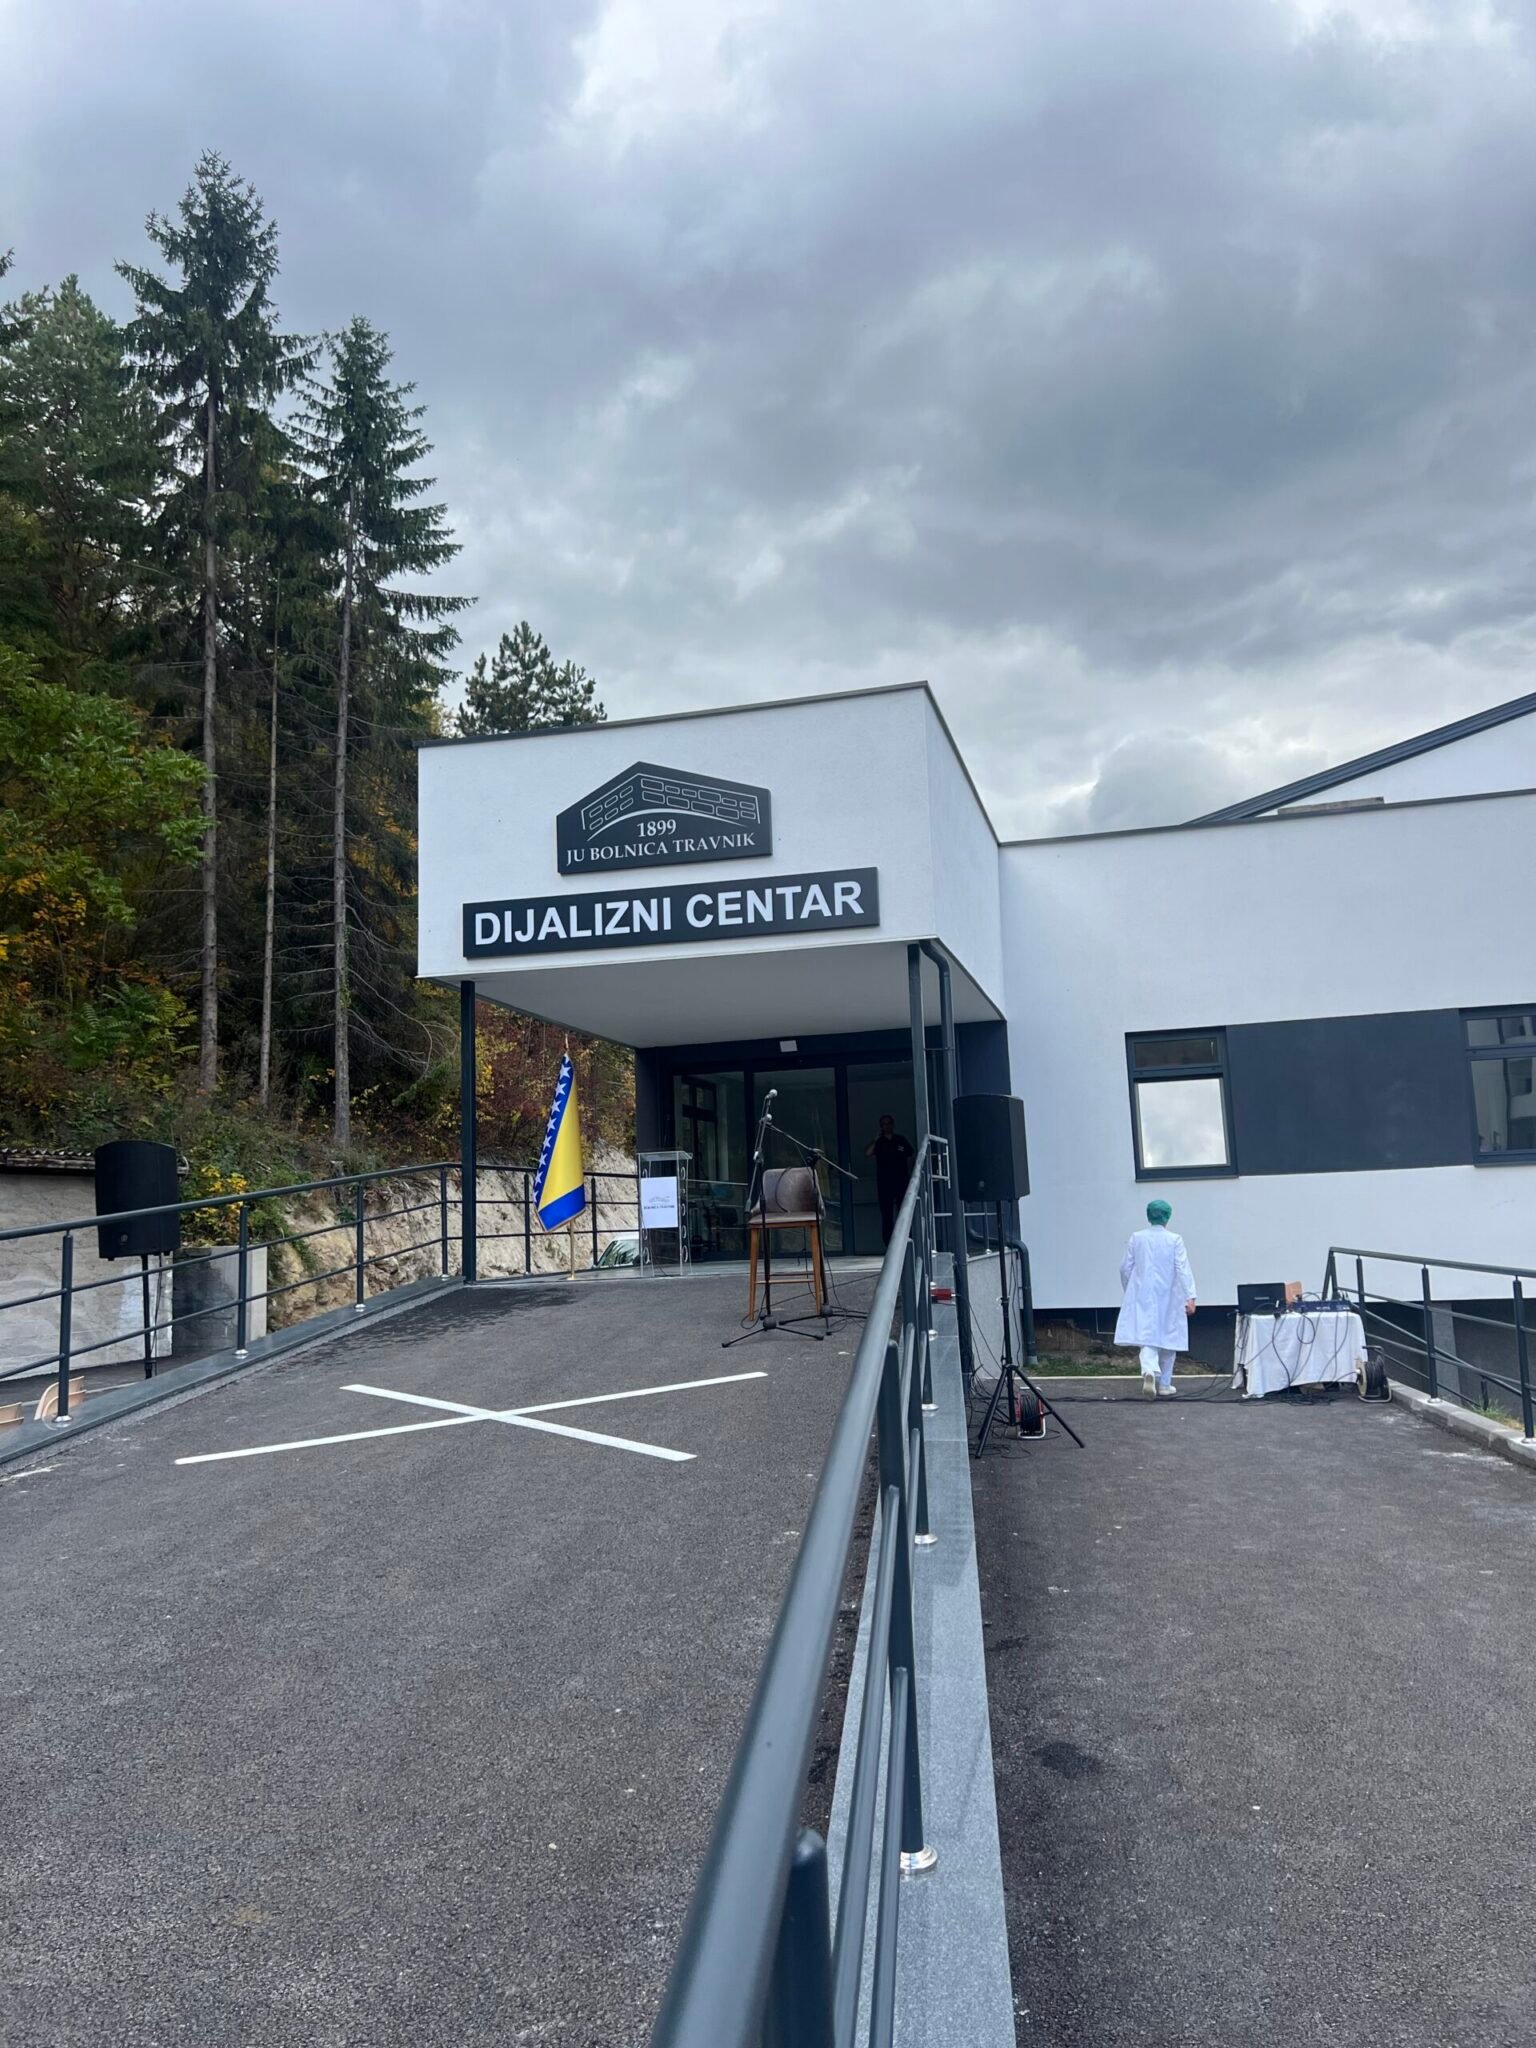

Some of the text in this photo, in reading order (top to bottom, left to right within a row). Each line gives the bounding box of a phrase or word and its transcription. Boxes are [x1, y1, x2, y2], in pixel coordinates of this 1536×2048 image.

[637, 819, 677, 837] 1899
[566, 832, 756, 866] JU BOLNICA TRAVNIK
[474, 881, 864, 946] DIJALIZNI CENTAR
